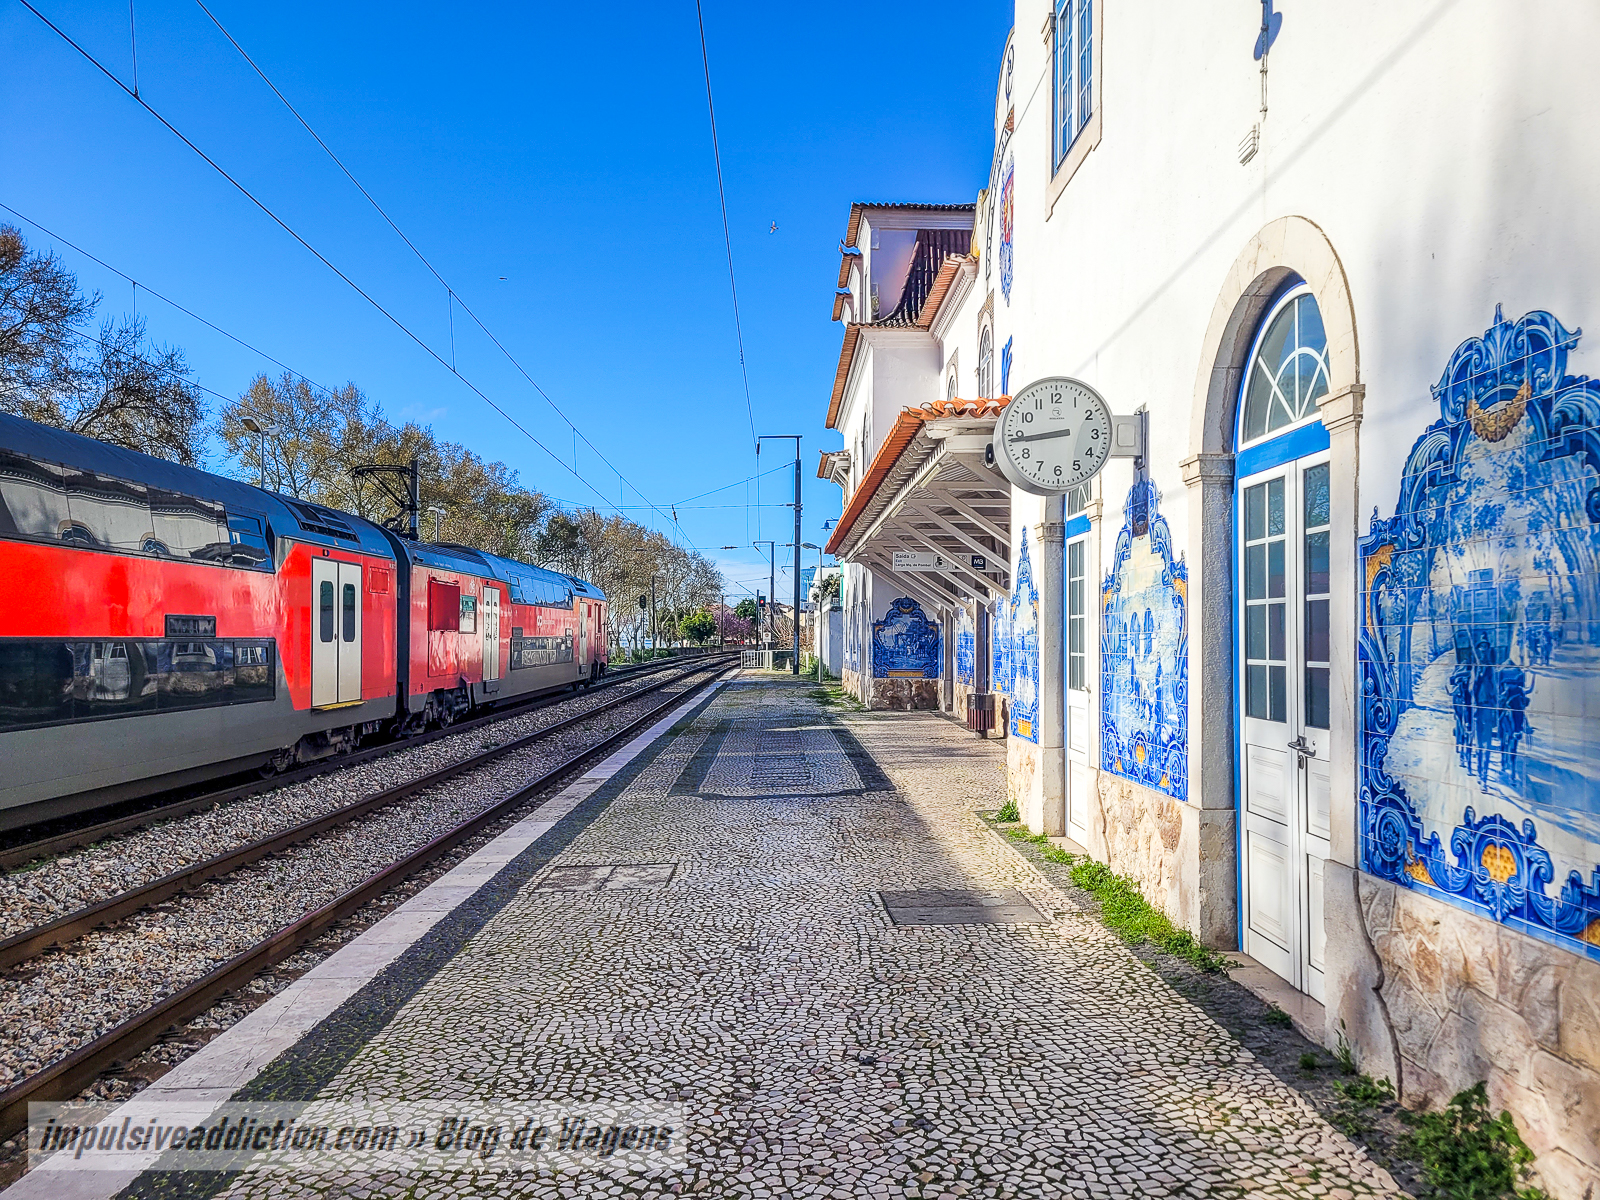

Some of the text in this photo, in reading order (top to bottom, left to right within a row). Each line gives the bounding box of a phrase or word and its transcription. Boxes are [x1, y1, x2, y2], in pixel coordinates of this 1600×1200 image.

[1051, 393, 1062, 403] 12
[1036, 399, 1042, 410] 11
[1022, 412, 1034, 423] 10
[1085, 410, 1093, 420] 2
[1091, 428, 1100, 440] 3
[1022, 448, 1030, 459] 8
[1085, 447, 1094, 458] 4
[1036, 461, 1044, 472] 7
[1054, 466, 1062, 476] 6
[1072, 460, 1081, 471] 5
